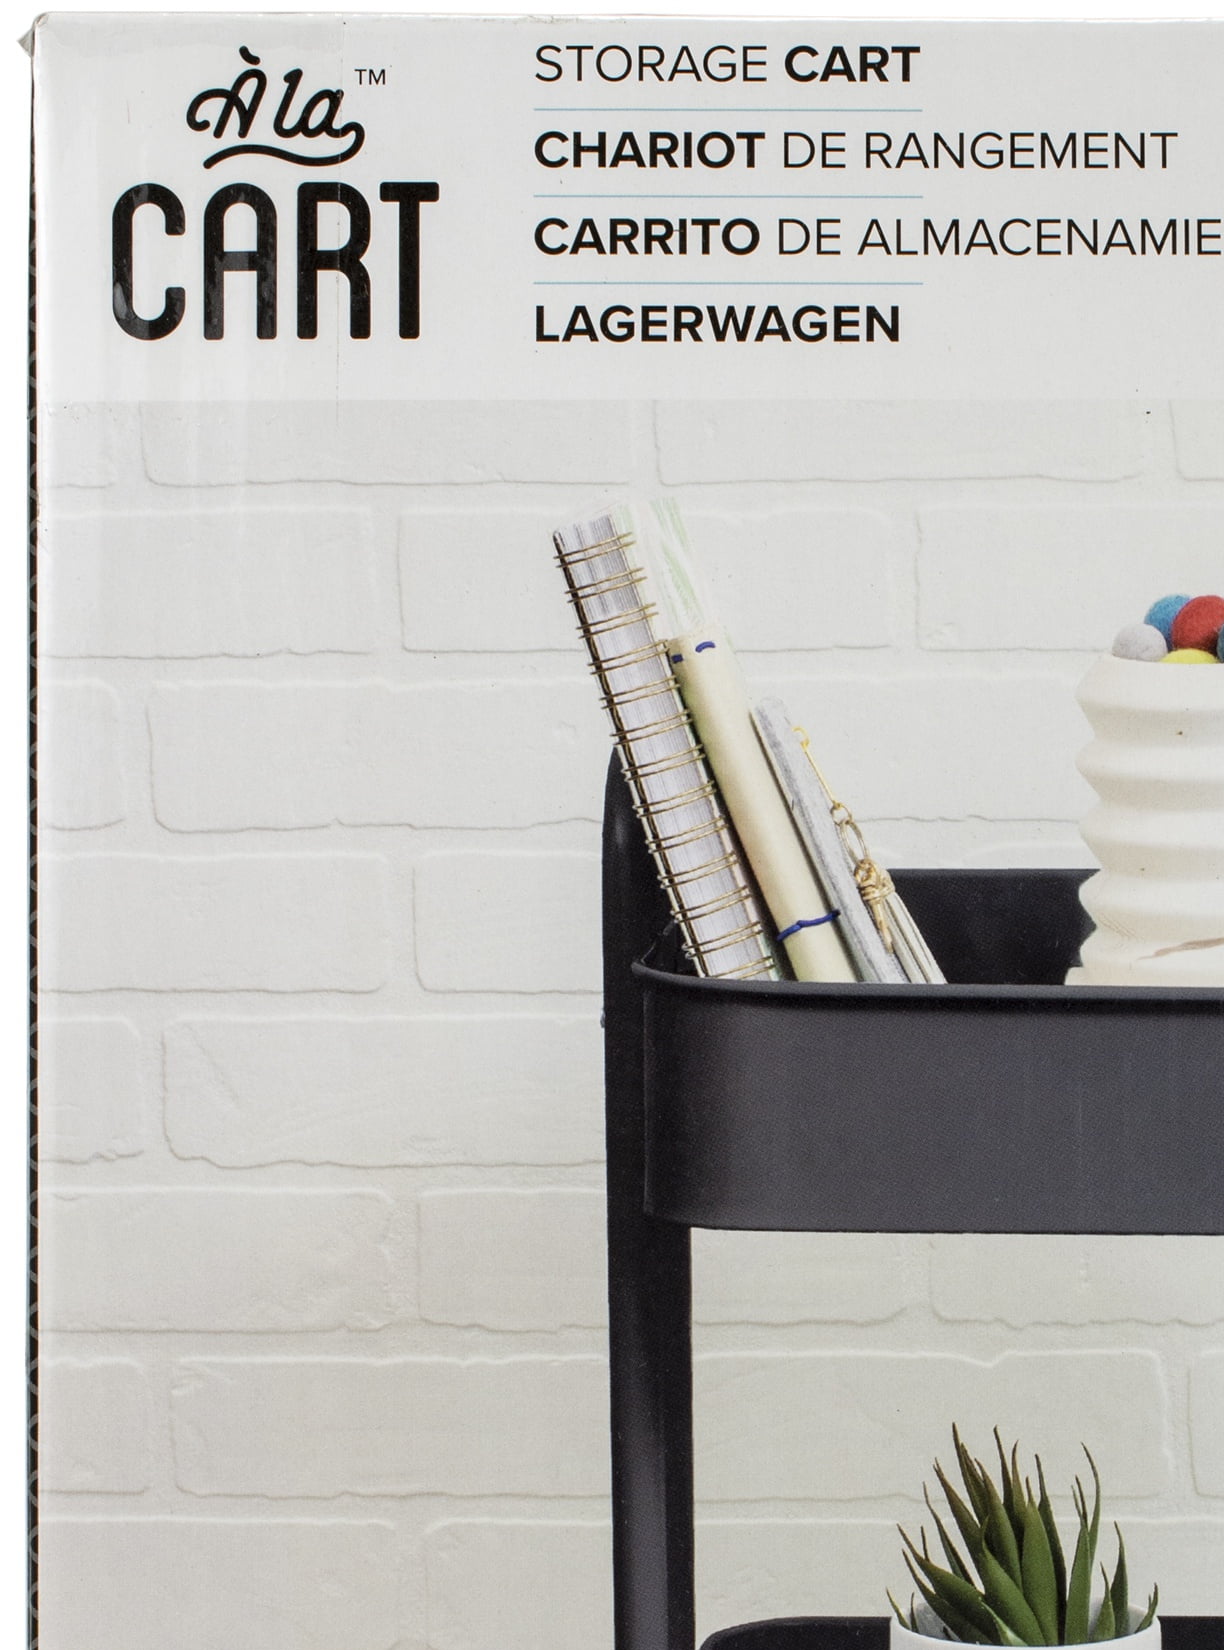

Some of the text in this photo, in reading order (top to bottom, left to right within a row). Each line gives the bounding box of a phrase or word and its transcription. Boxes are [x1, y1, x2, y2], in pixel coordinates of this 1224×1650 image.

[535, 44, 921, 83] STORAGE CART
[186, 45, 269, 140] À
[275, 67, 366, 167] la
[534, 130, 1179, 170] CHARIOT DE RANGEMENT
[535, 217, 761, 256] CARRITO
[778, 218, 841, 256] DE
[111, 181, 440, 341] CART
[535, 304, 900, 343] LAGERWAGEN
